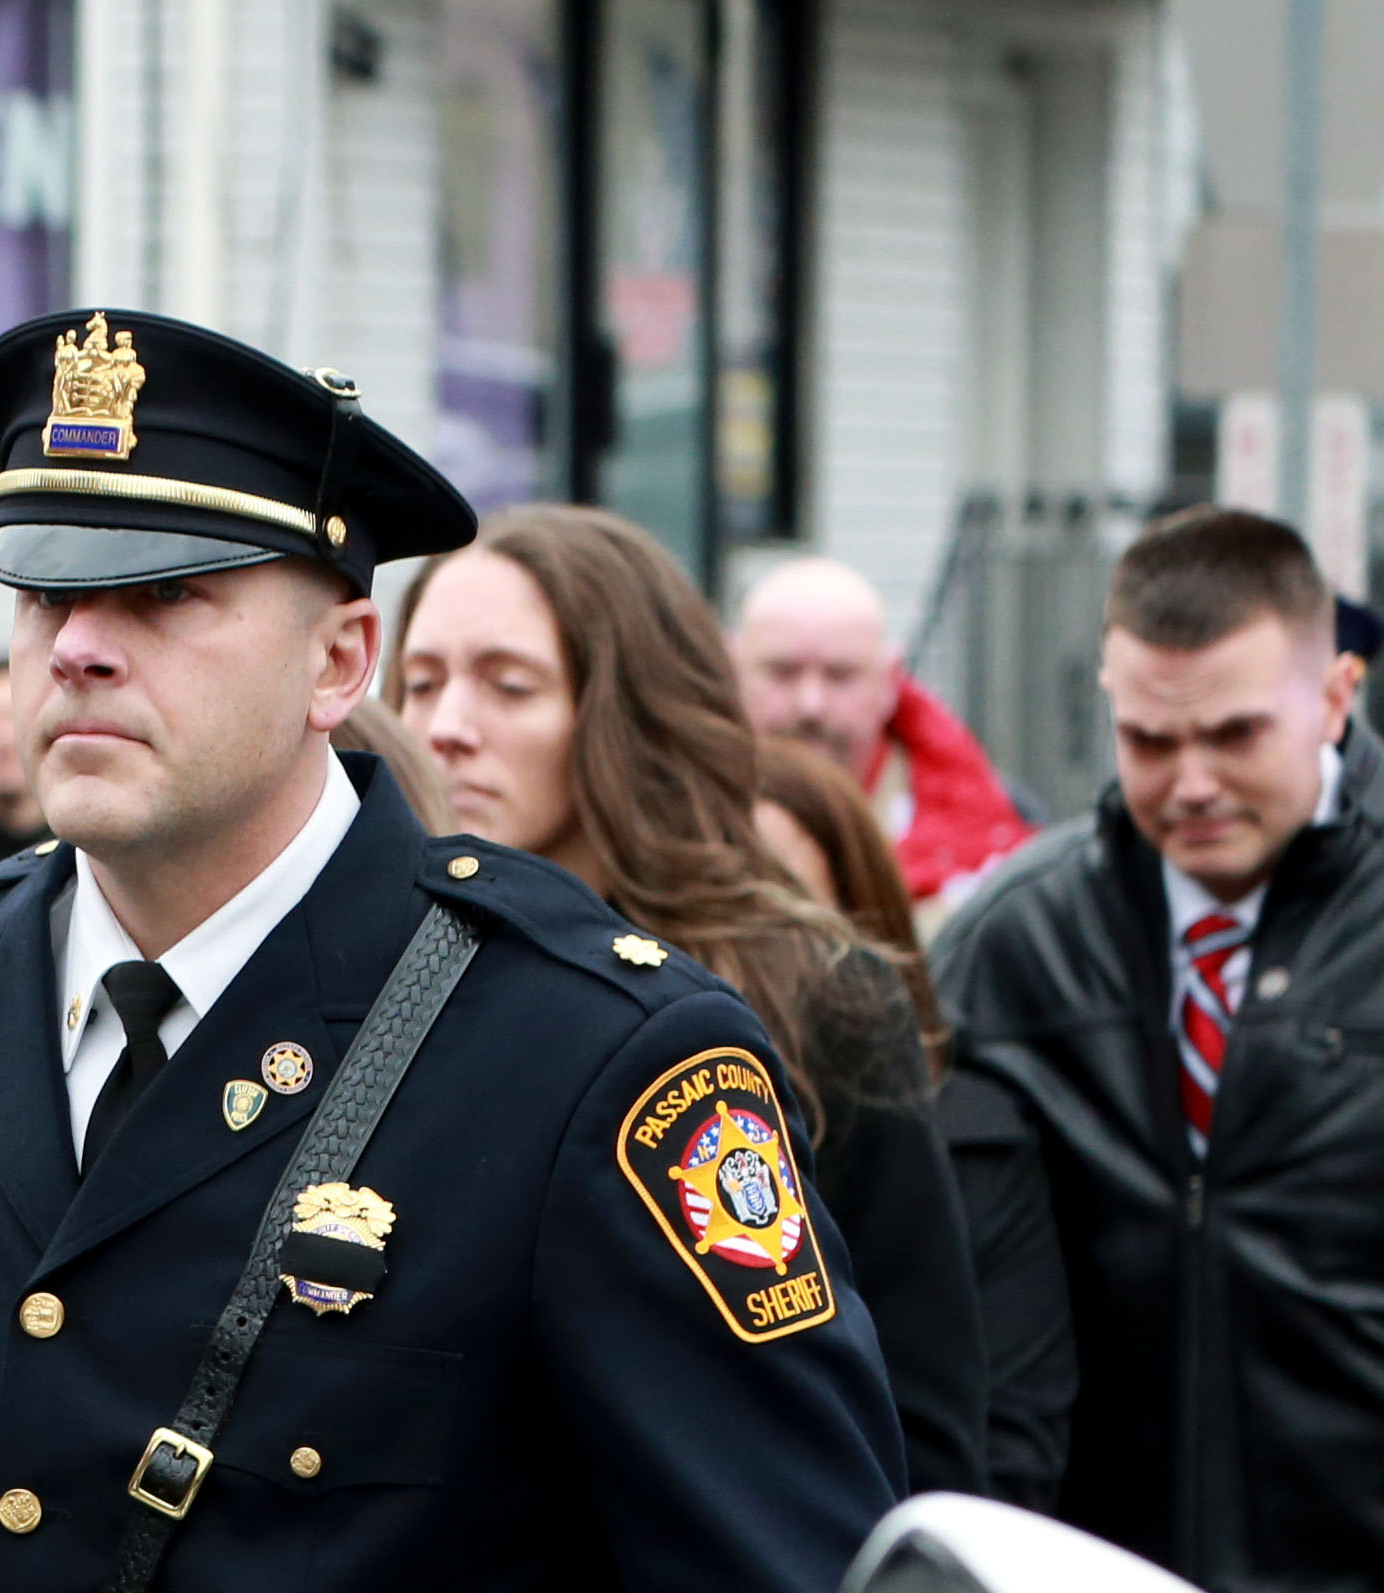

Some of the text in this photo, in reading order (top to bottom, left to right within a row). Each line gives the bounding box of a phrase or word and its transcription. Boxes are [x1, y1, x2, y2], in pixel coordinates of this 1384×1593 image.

[52, 427, 117, 445] COMMANDER
[634, 1063, 771, 1150] PASSAIC COUNTY
[746, 1272, 824, 1327] SHERIFF
